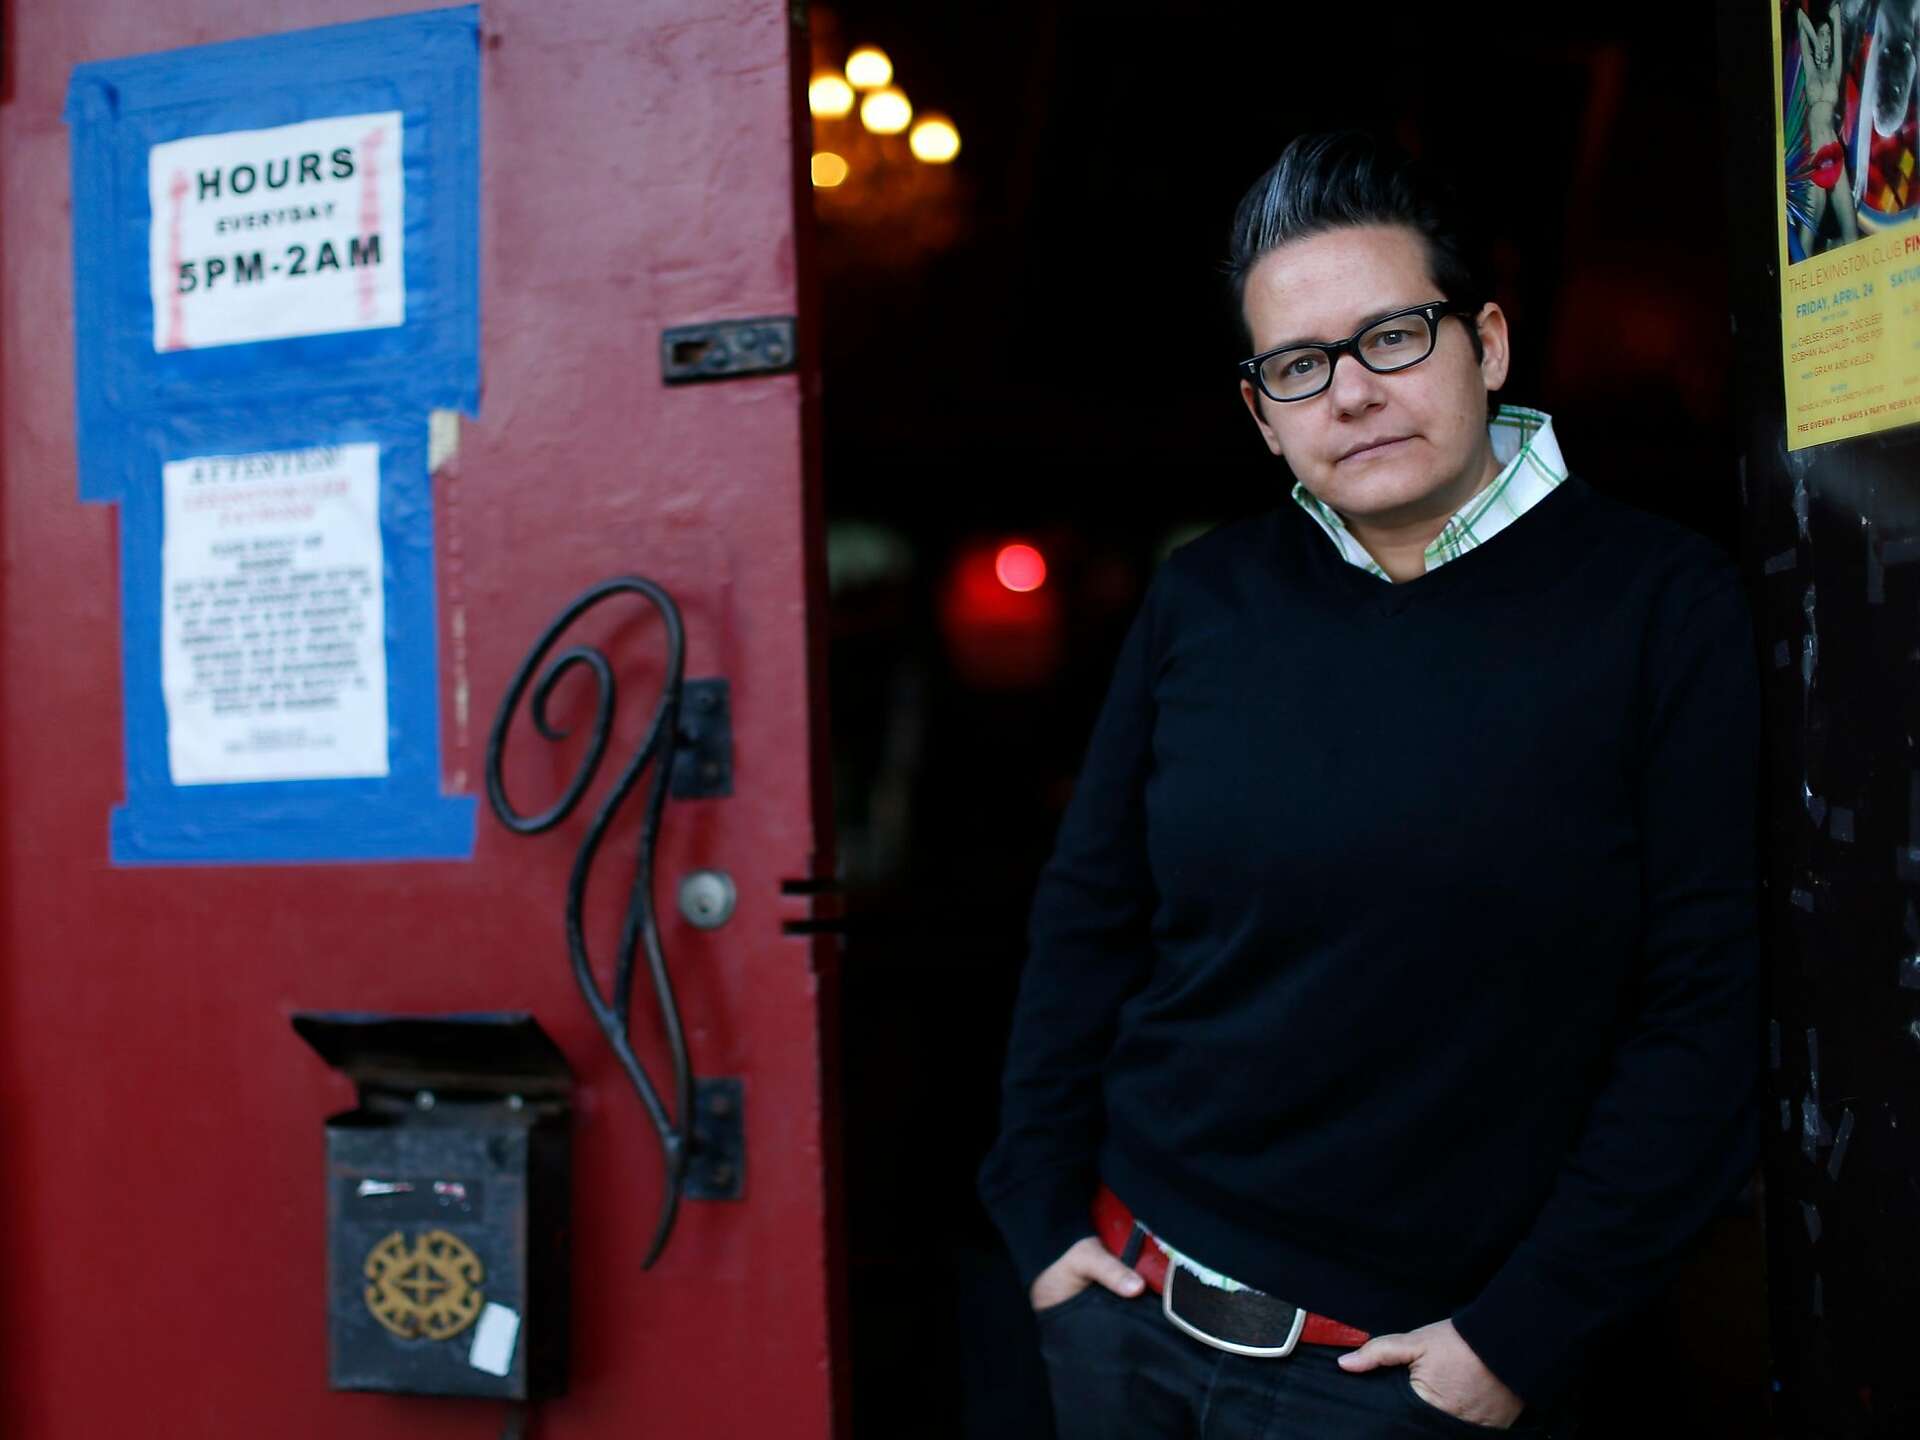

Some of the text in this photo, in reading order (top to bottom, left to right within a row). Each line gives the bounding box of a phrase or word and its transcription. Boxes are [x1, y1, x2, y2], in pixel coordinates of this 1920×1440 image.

[198, 147, 357, 201] HOURS
[216, 202, 337, 235] EVERYDAY
[177, 234, 382, 294] 5PM-2AM
[1789, 272, 1808, 293] THE
[1810, 252, 1871, 289] LEXINGTON
[1871, 240, 1902, 266] CLUB
[1833, 288, 1860, 305] APRIL
